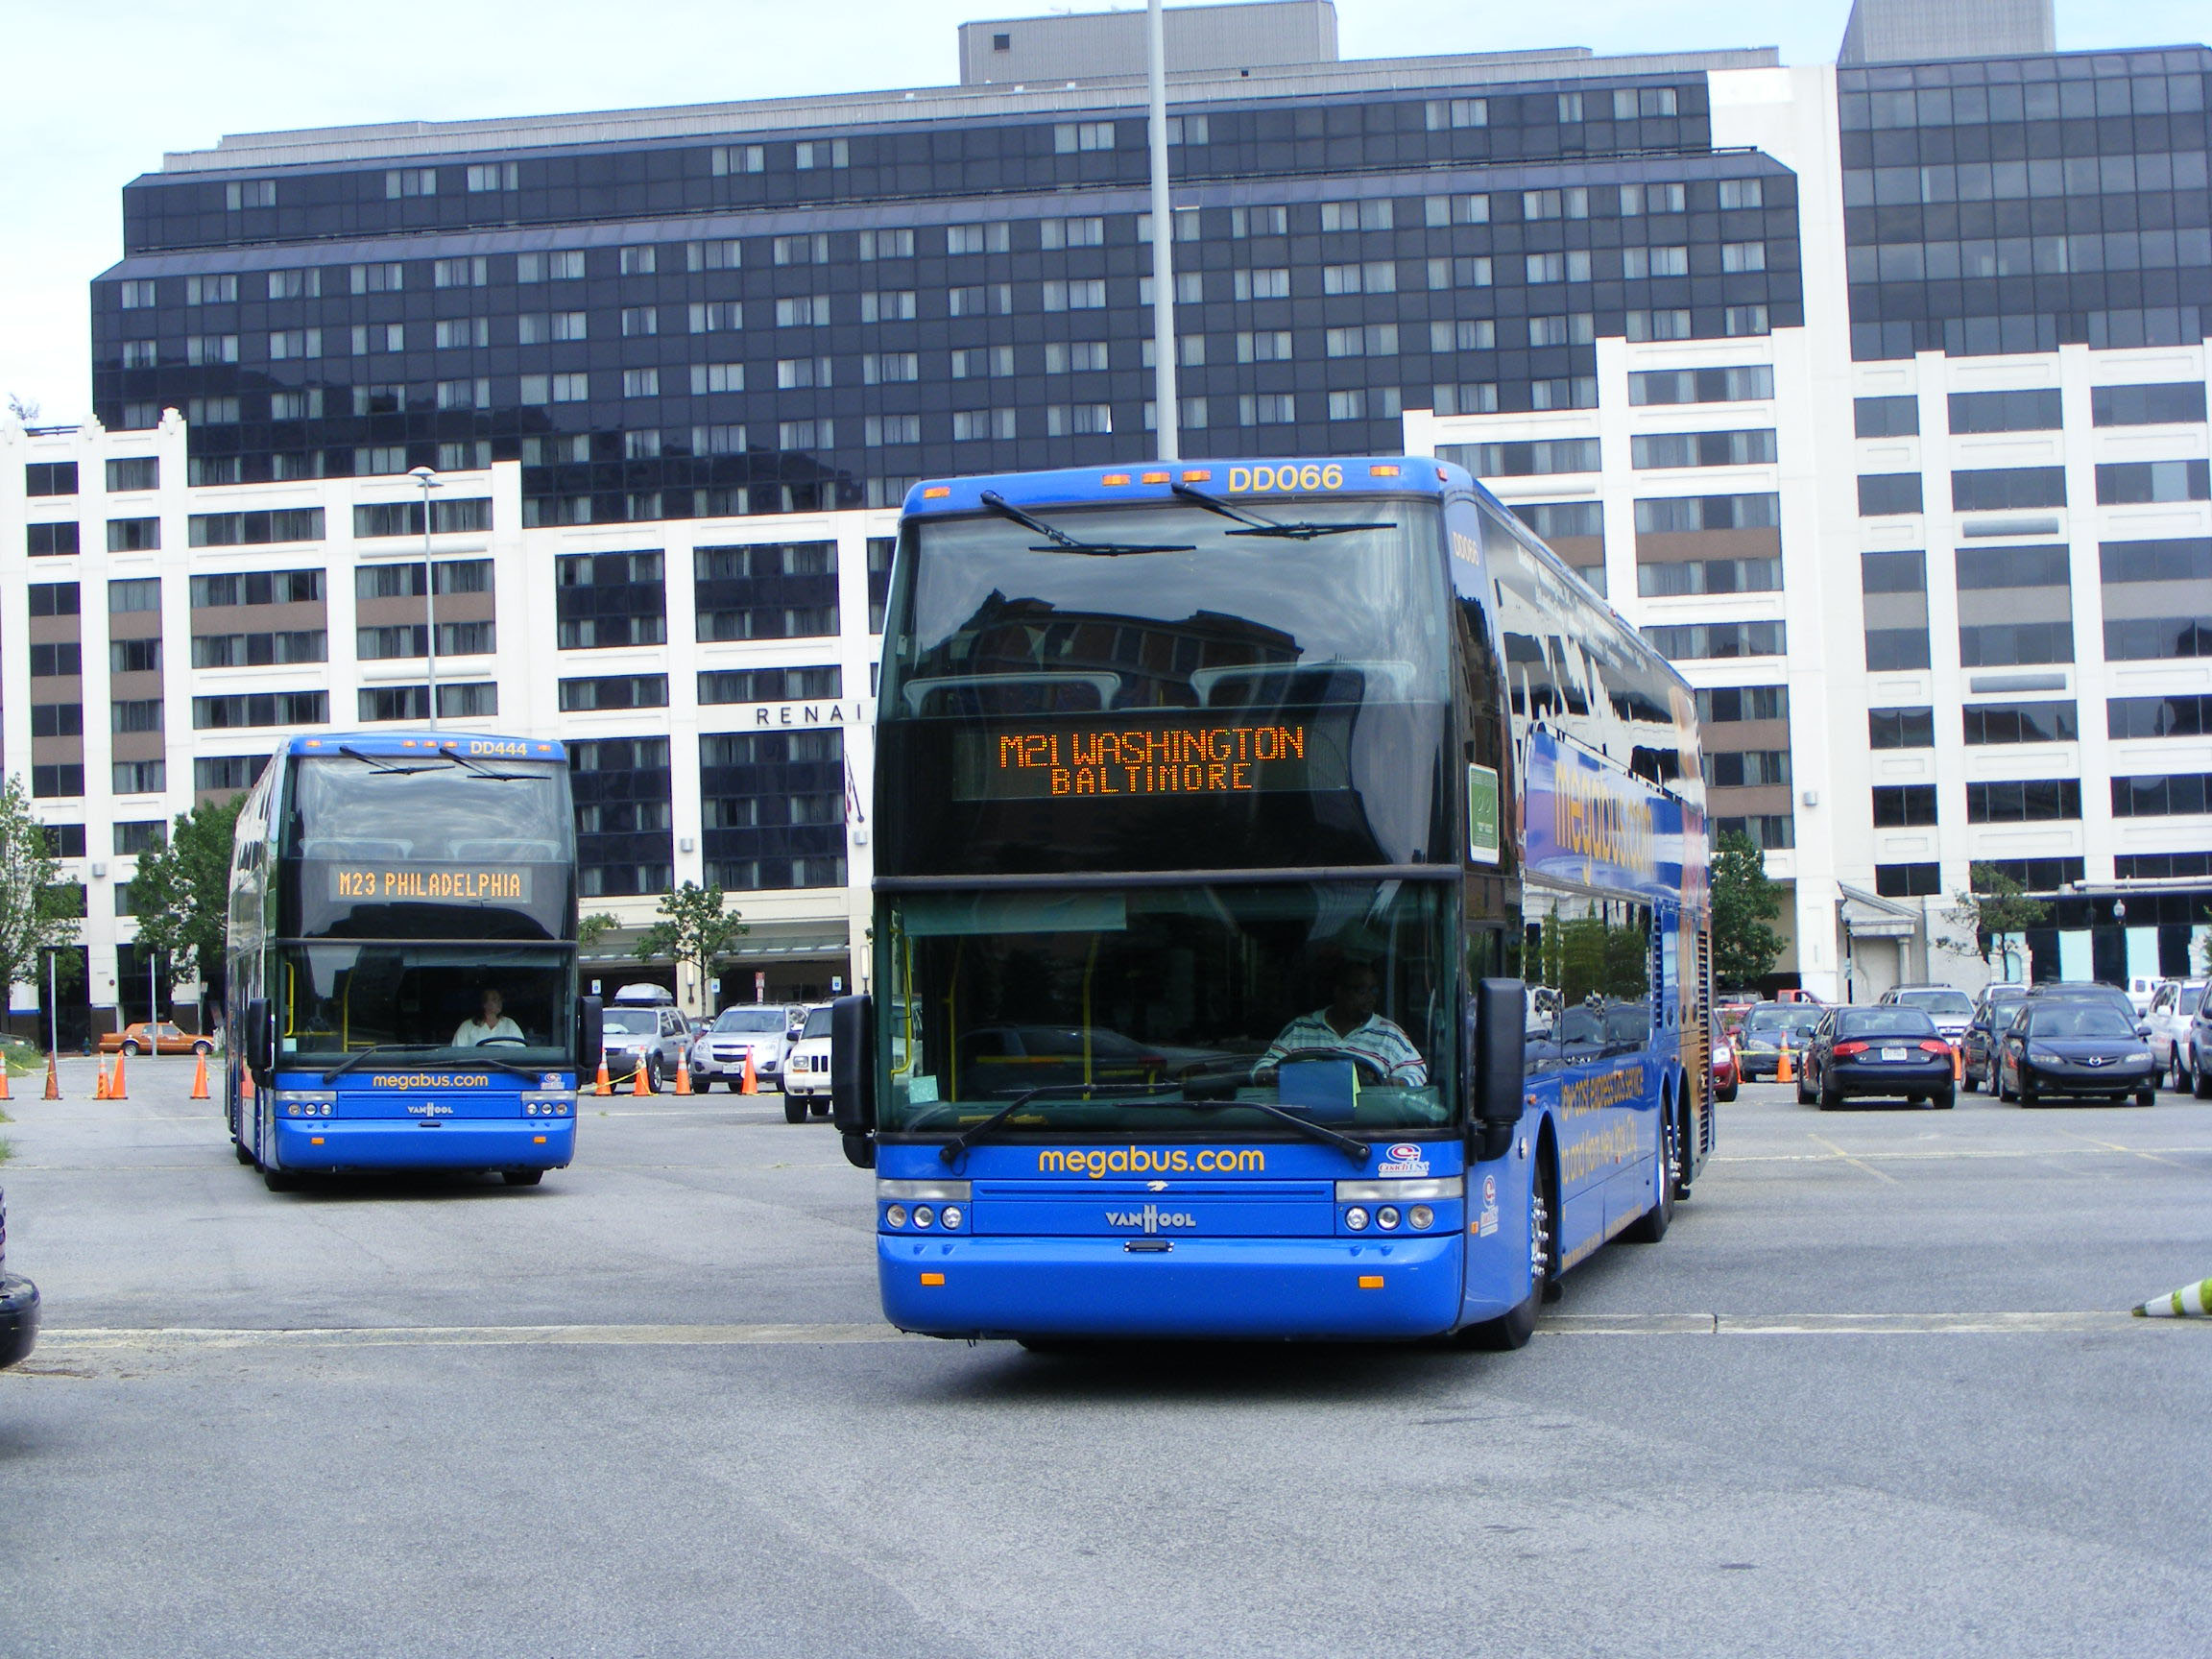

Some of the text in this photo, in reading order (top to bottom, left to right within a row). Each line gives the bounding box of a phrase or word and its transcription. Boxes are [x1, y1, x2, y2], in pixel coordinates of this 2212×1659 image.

[1229, 464, 1343, 492] DD066
[470, 741, 527, 756] DD444
[1000, 727, 1304, 768] M21 WASHINGTON
[1051, 762, 1252, 795] BALTIMORE
[339, 872, 521, 897] M23 PHILADELPHIA
[373, 1073, 489, 1090] megabus.com
[1039, 1145, 1264, 1179] megabus.com
